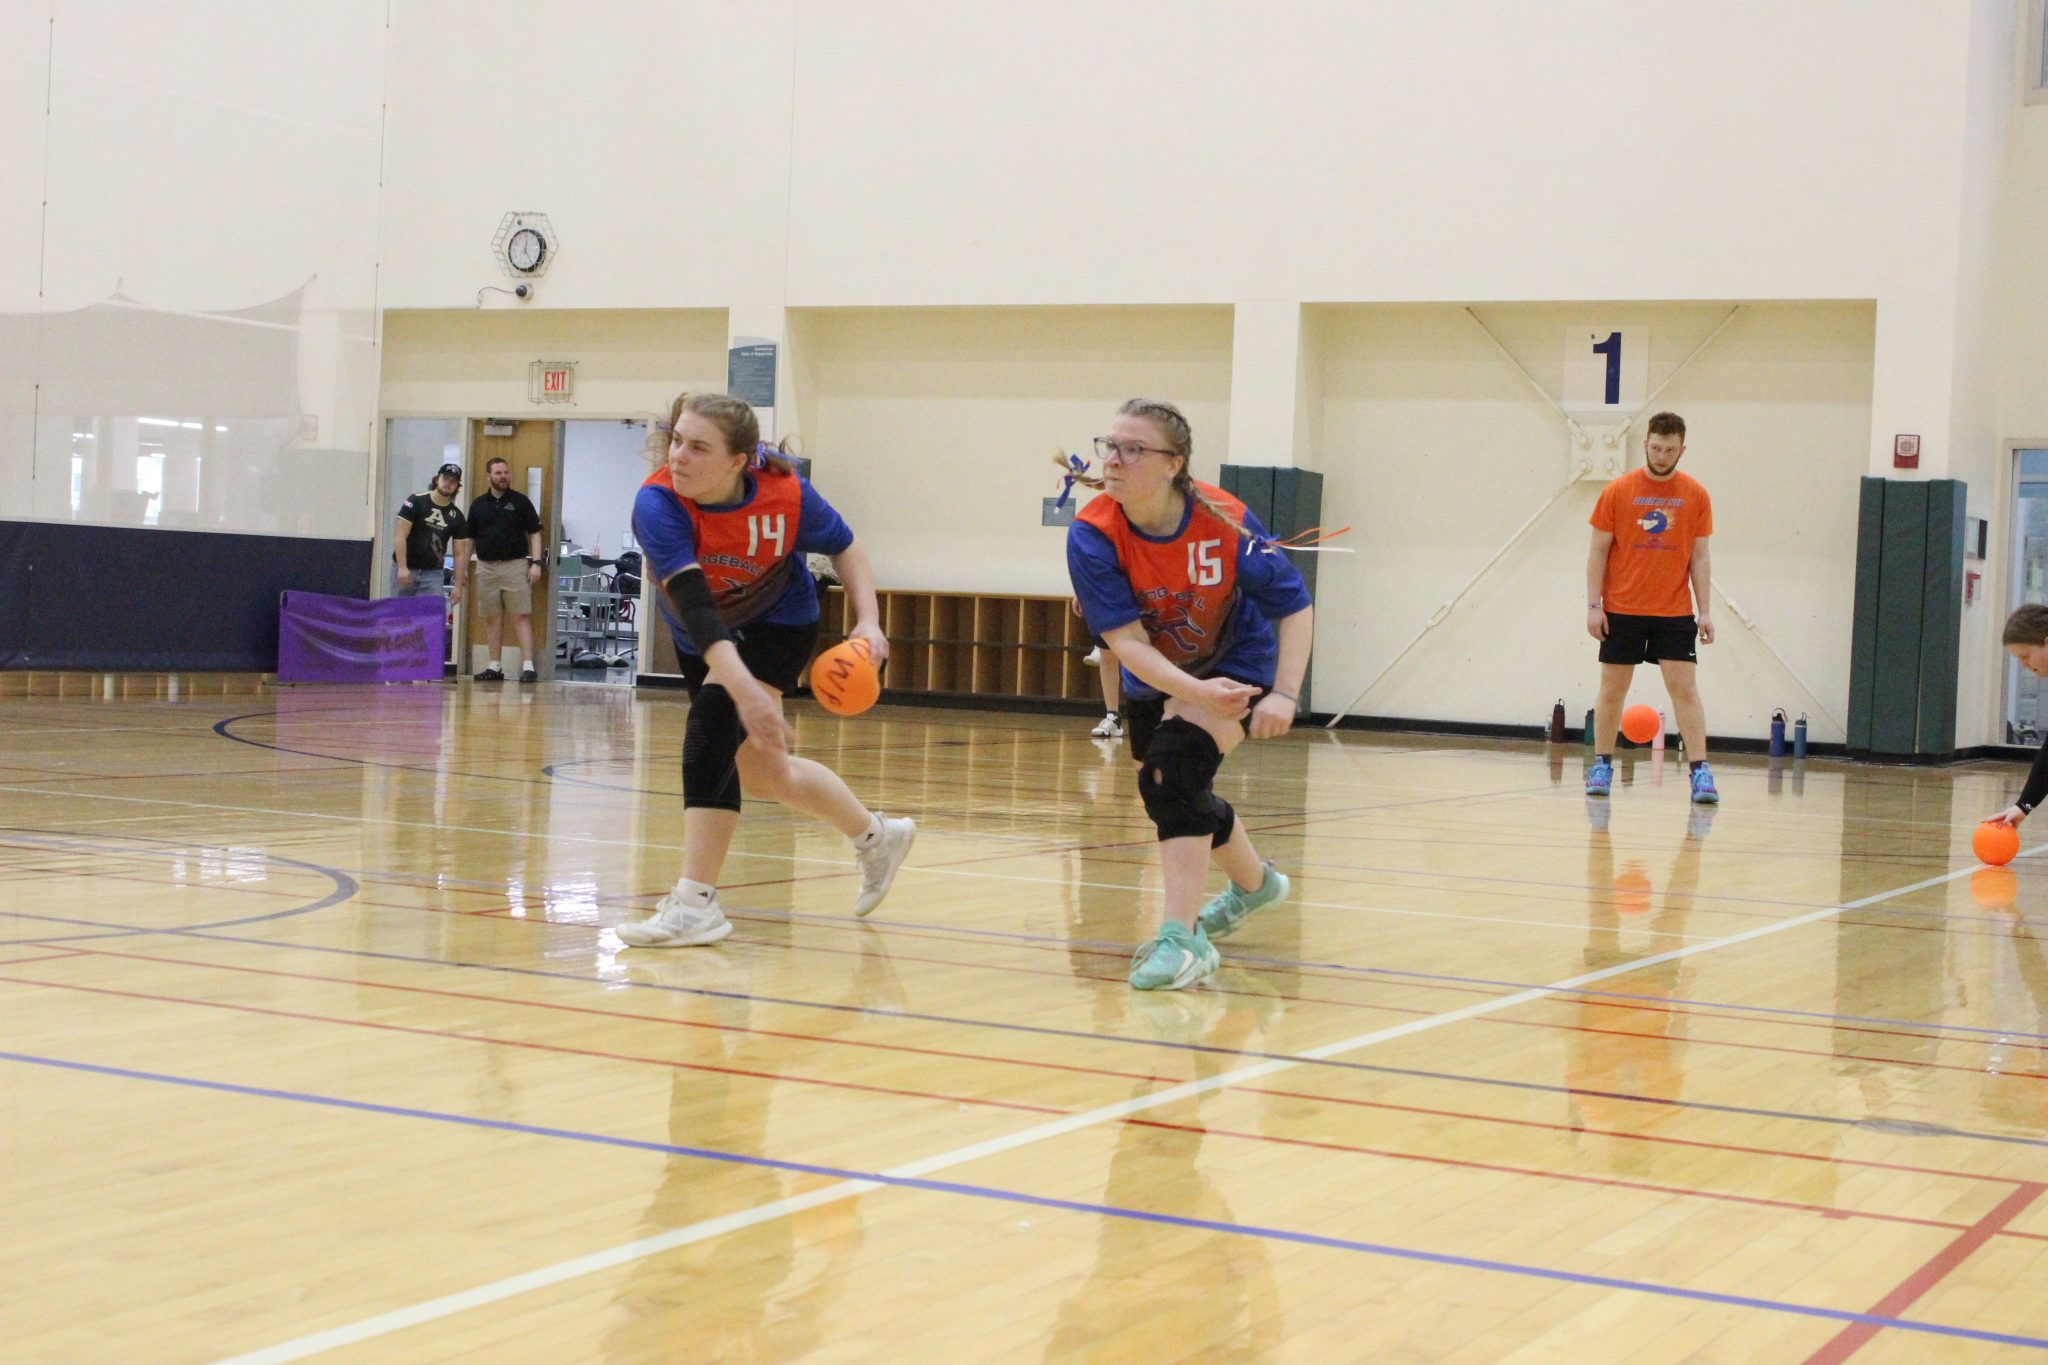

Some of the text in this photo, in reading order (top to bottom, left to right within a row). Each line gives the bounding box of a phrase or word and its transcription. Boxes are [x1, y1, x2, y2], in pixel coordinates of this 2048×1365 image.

[544, 370, 566, 391] EXIT
[1591, 331, 1622, 404] 1
[424, 507, 448, 528] A
[746, 513, 785, 557] 14
[1187, 538, 1223, 587] 15
